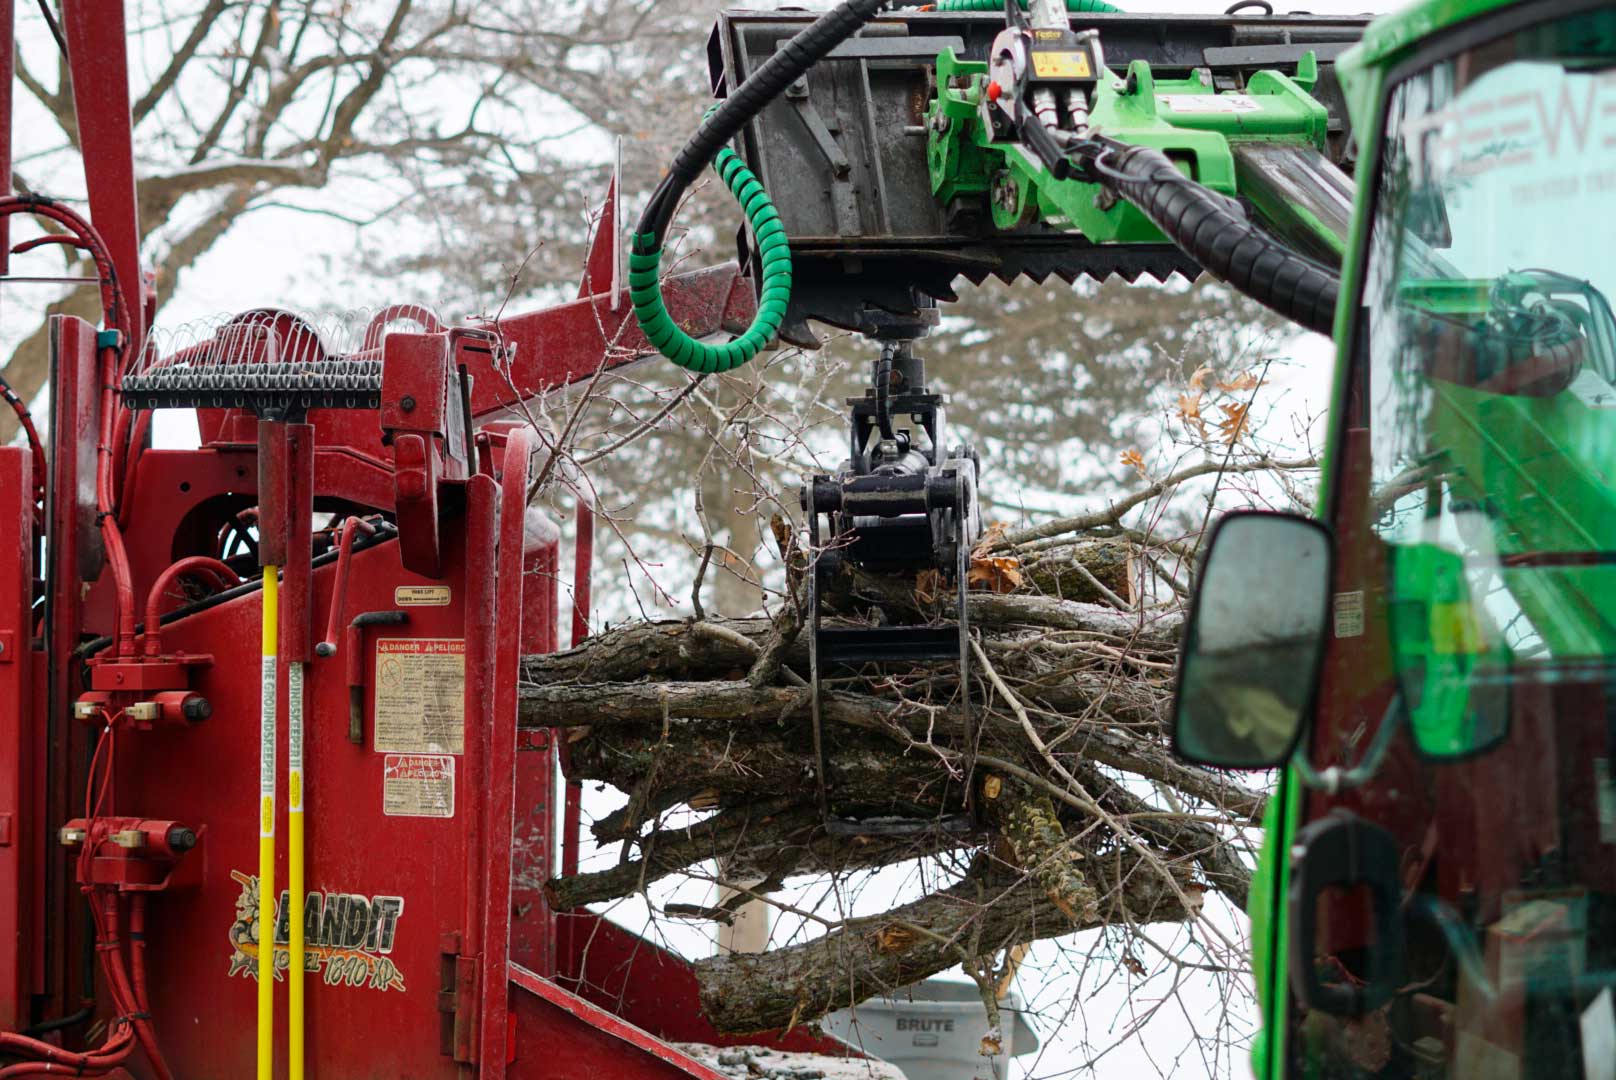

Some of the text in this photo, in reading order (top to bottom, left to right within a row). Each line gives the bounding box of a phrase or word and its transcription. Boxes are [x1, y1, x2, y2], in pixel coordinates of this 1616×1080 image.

[389, 643, 465, 652] DANGER PELIGRO
[264, 659, 275, 680] THE
[263, 682, 275, 783] GROUNDSKEEPER
[369, 957, 396, 991] XP
[896, 1018, 955, 1032] BRUTE
